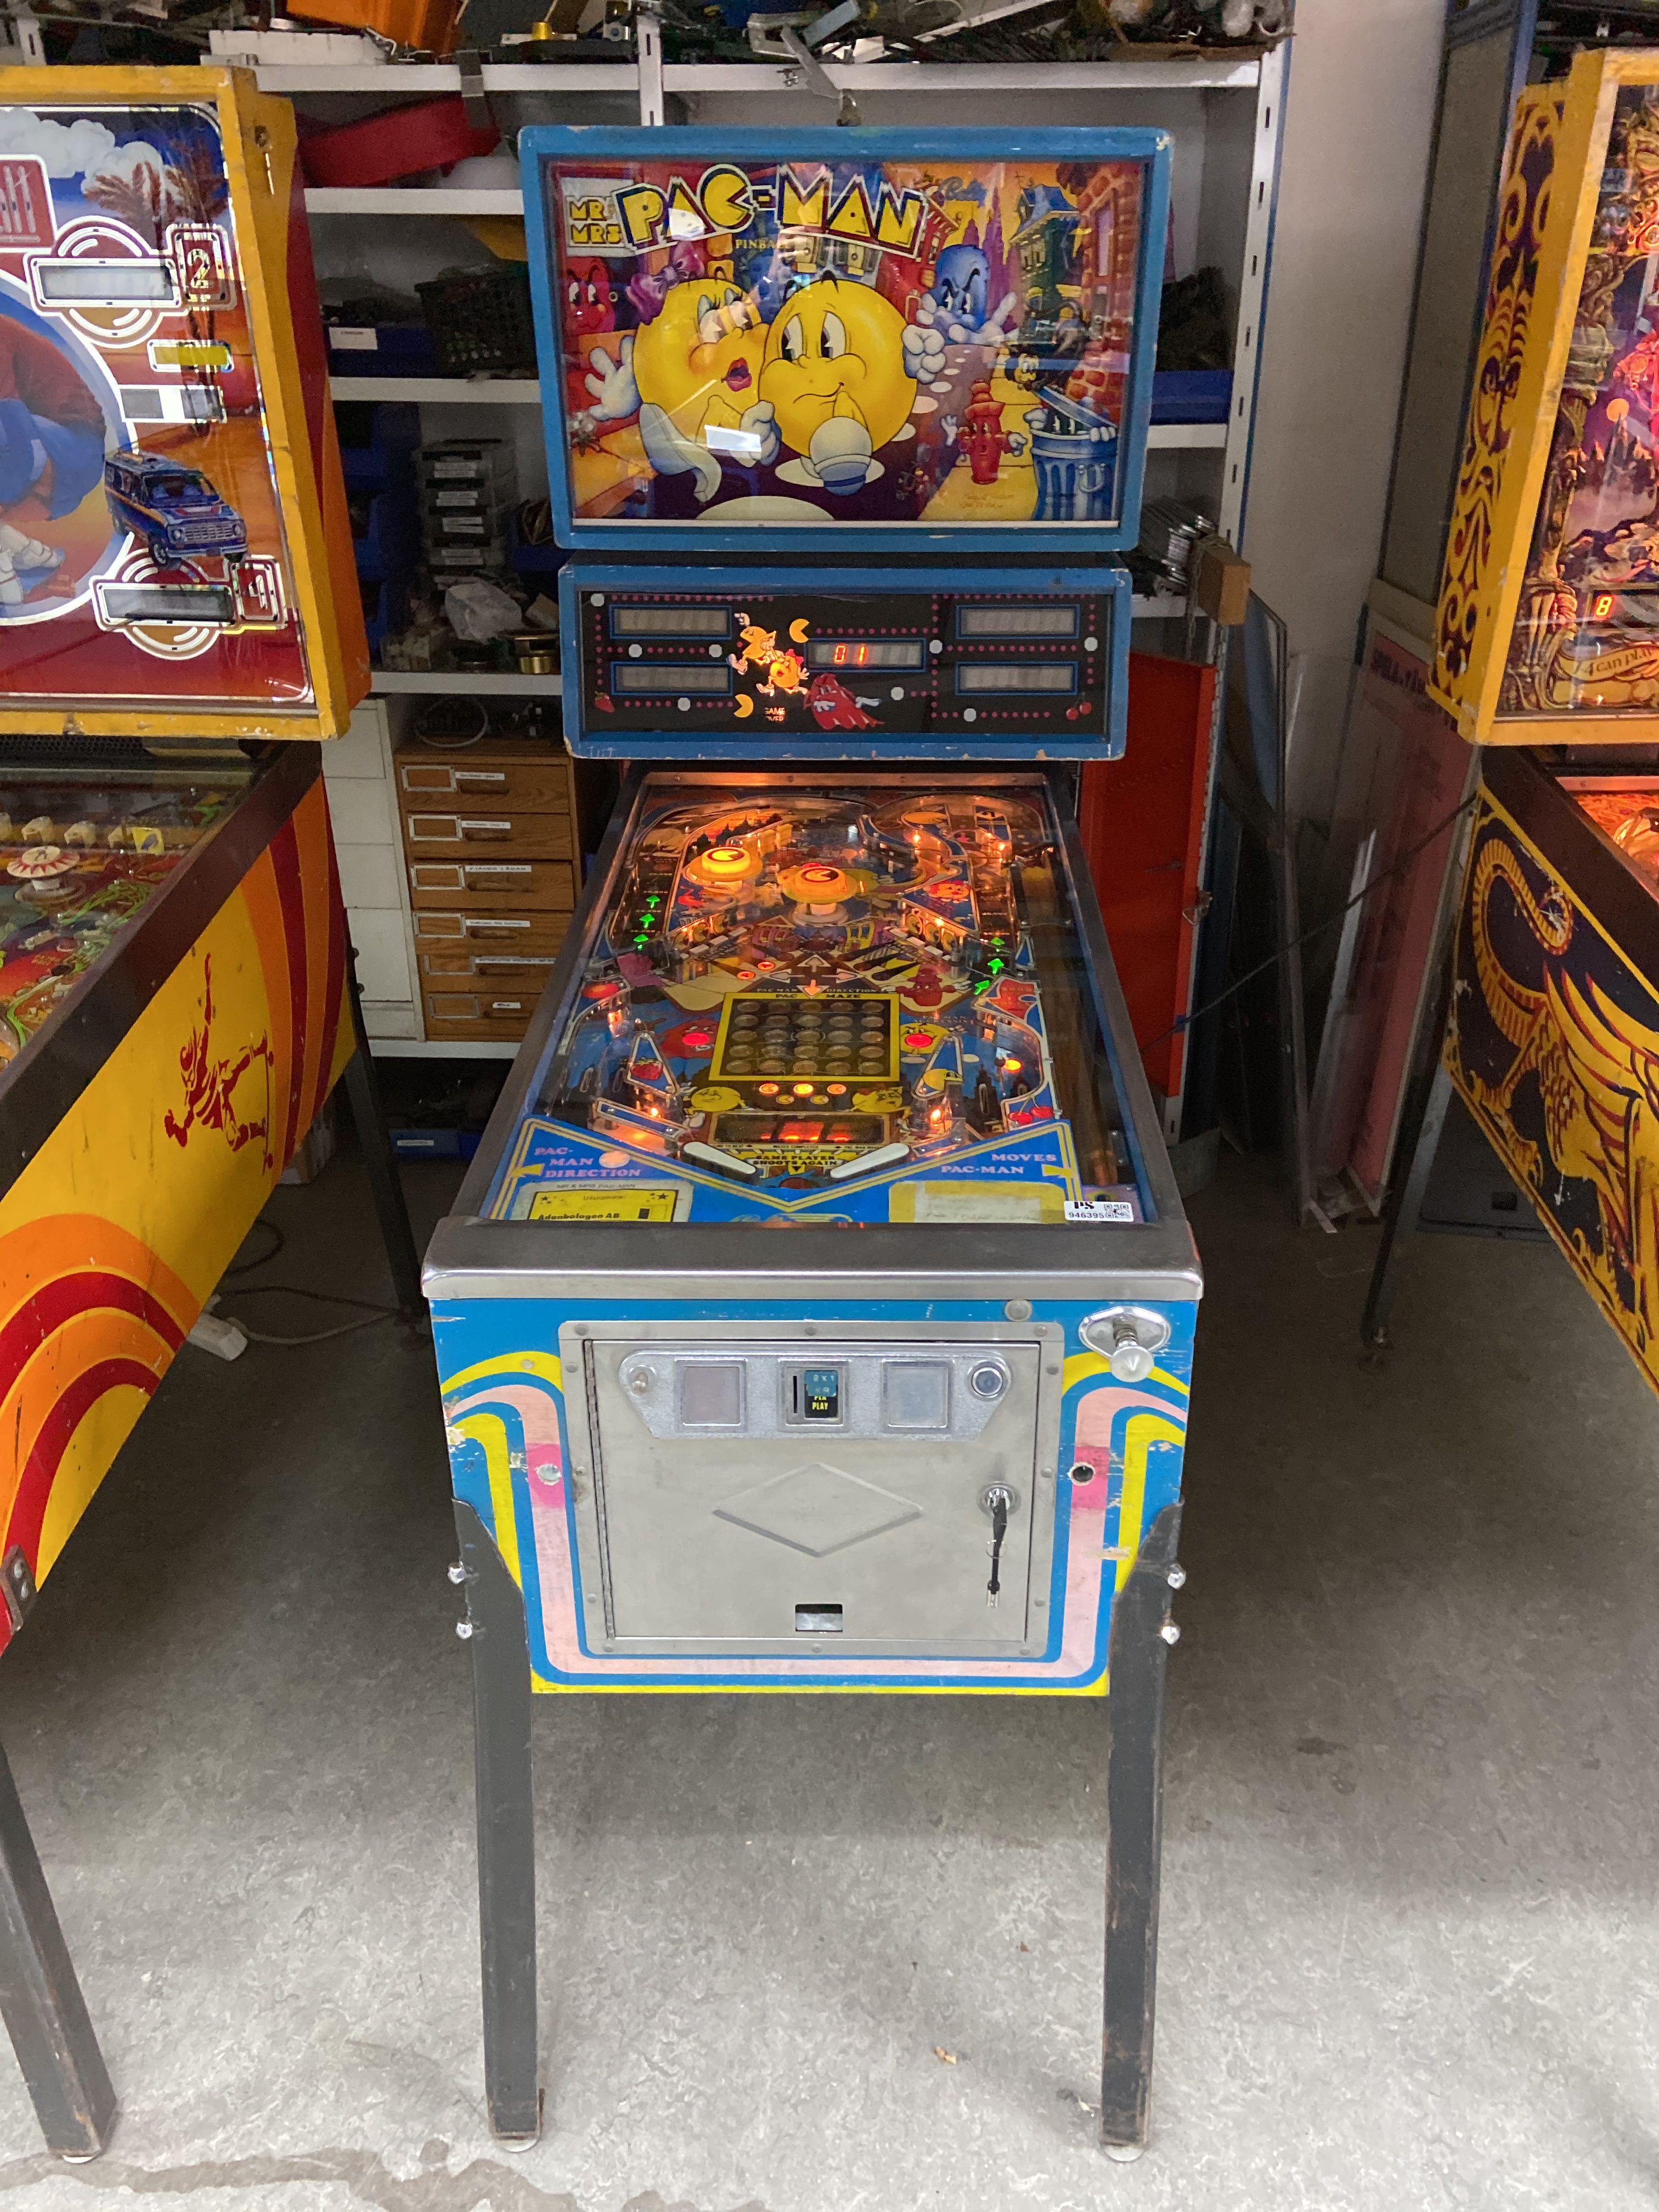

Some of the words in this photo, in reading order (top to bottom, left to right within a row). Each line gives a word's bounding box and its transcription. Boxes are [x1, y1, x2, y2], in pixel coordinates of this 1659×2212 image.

[569, 199, 607, 221] MR
[616, 166, 924, 254] PAC-MAN
[571, 223, 623, 244] MRS
[187, 249, 211, 289] 2
[1596, 596, 1612, 616] 8
[534, 1147, 573, 1155] PAC-
[545, 1169, 641, 1177] DIRECTION
